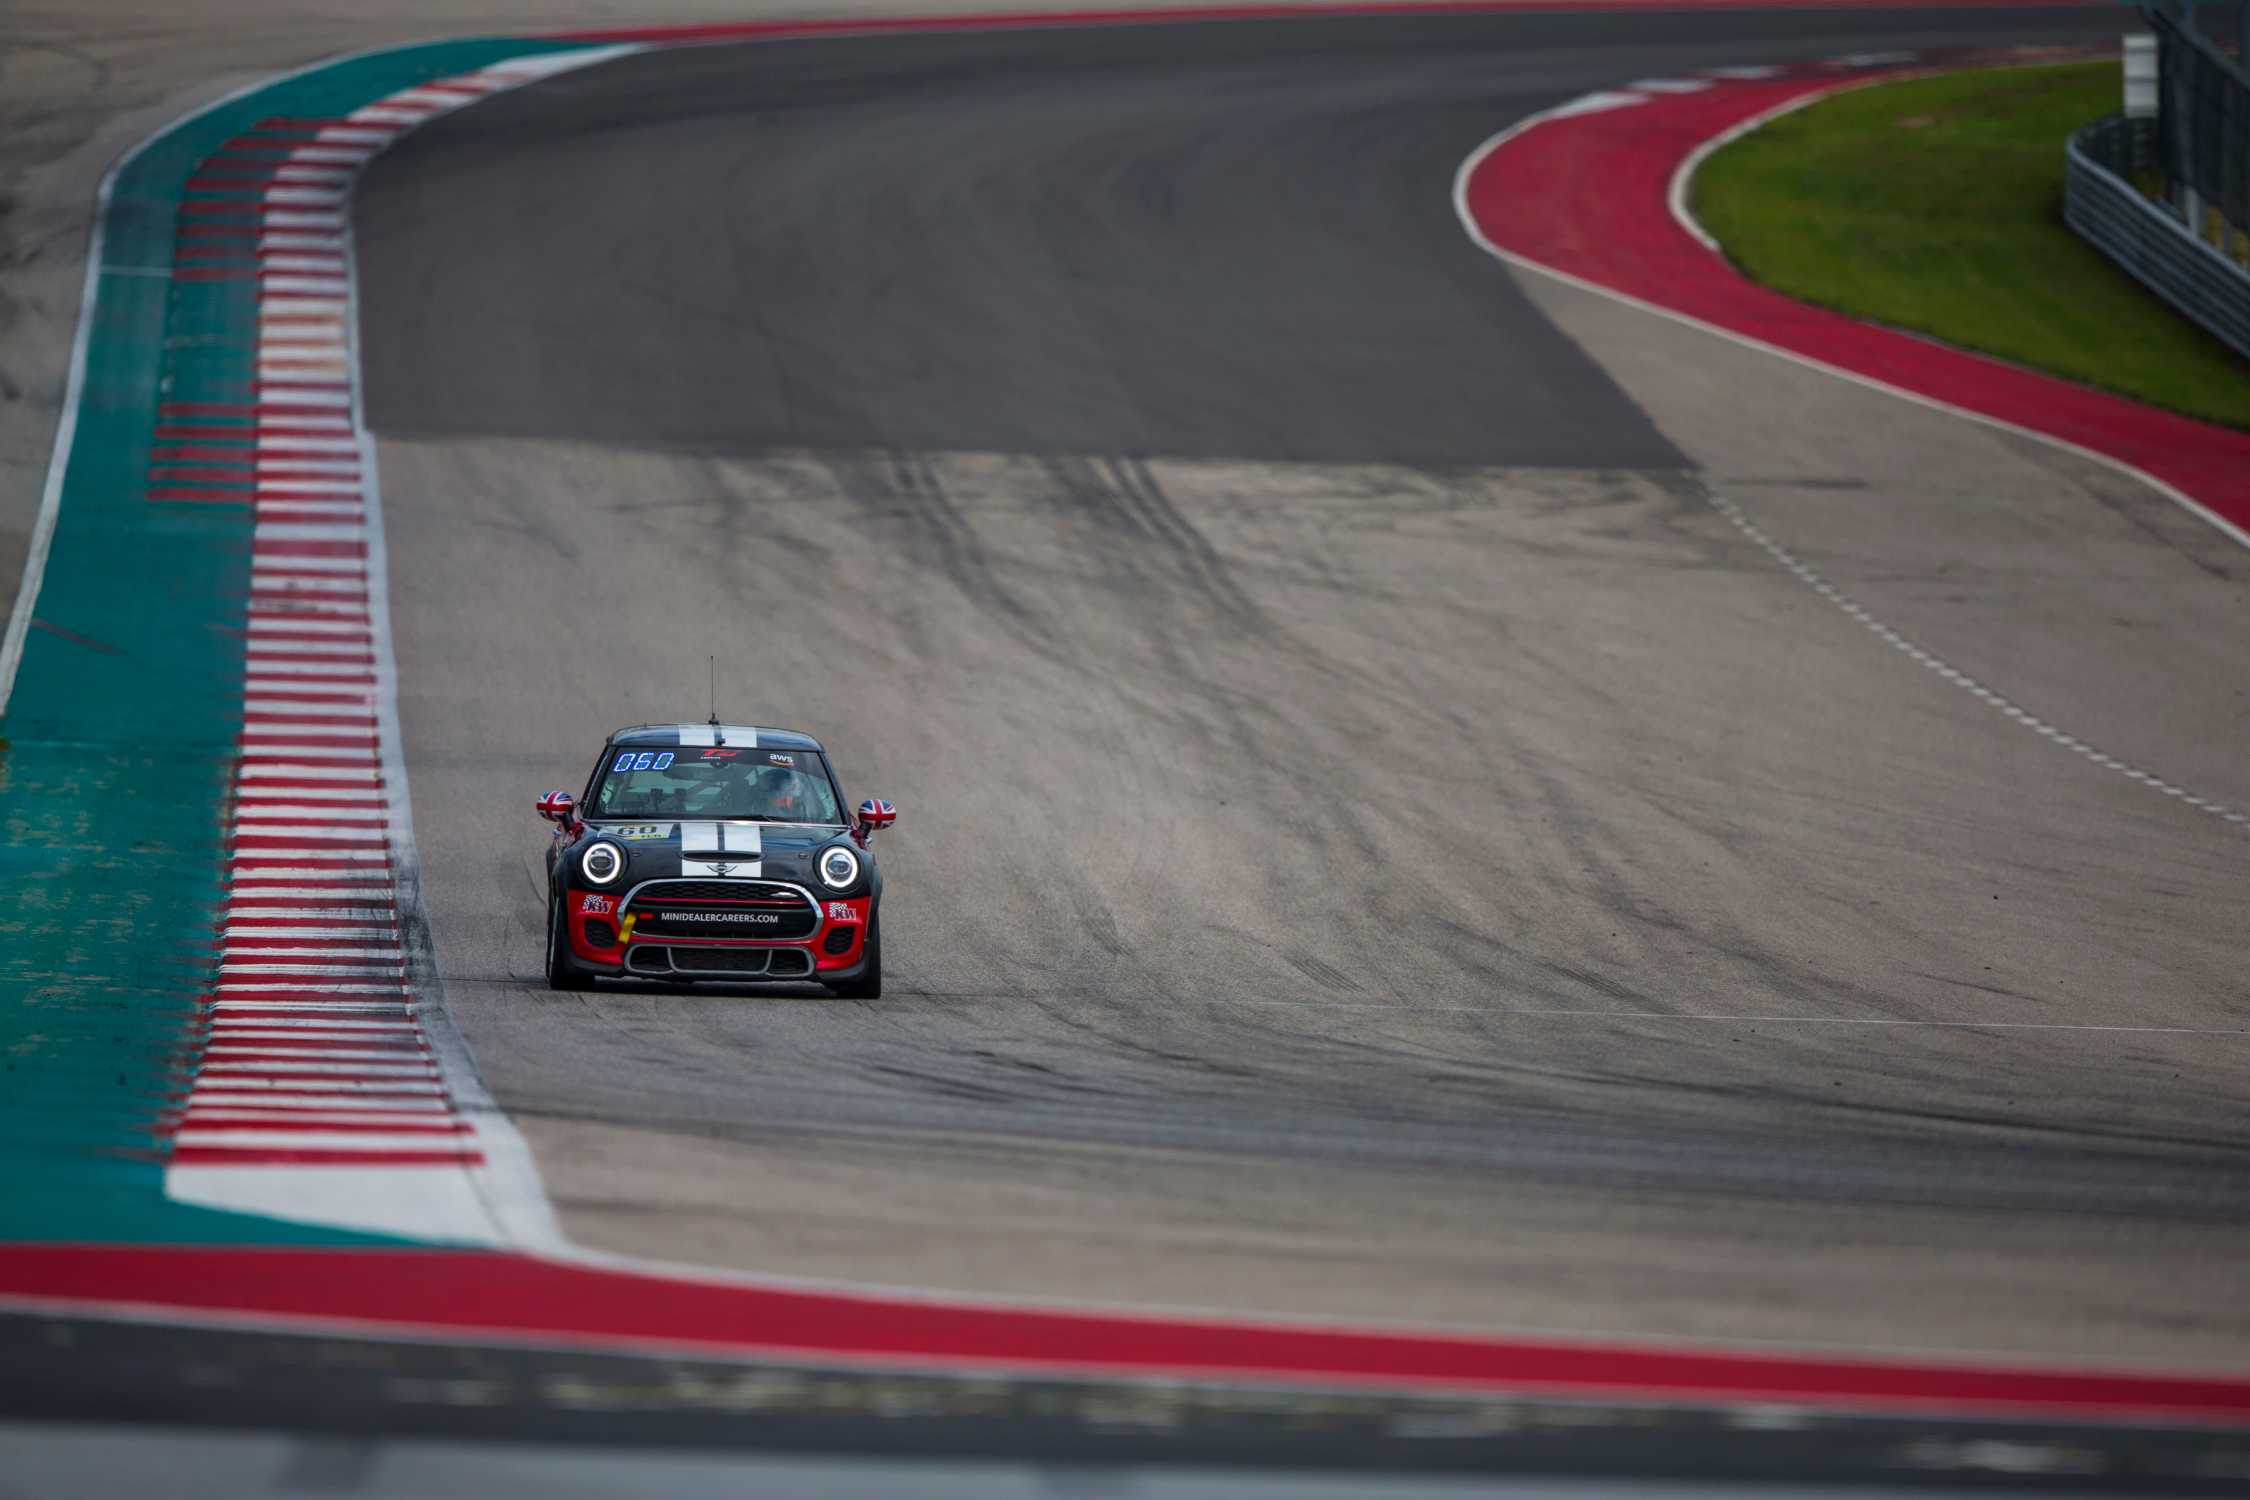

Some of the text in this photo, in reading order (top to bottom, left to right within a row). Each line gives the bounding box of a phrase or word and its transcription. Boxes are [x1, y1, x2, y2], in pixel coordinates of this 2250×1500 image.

[614, 752, 676, 772] 060
[769, 753, 793, 763] aws
[661, 912, 779, 923] MINIDEALERCAREERS.COM
